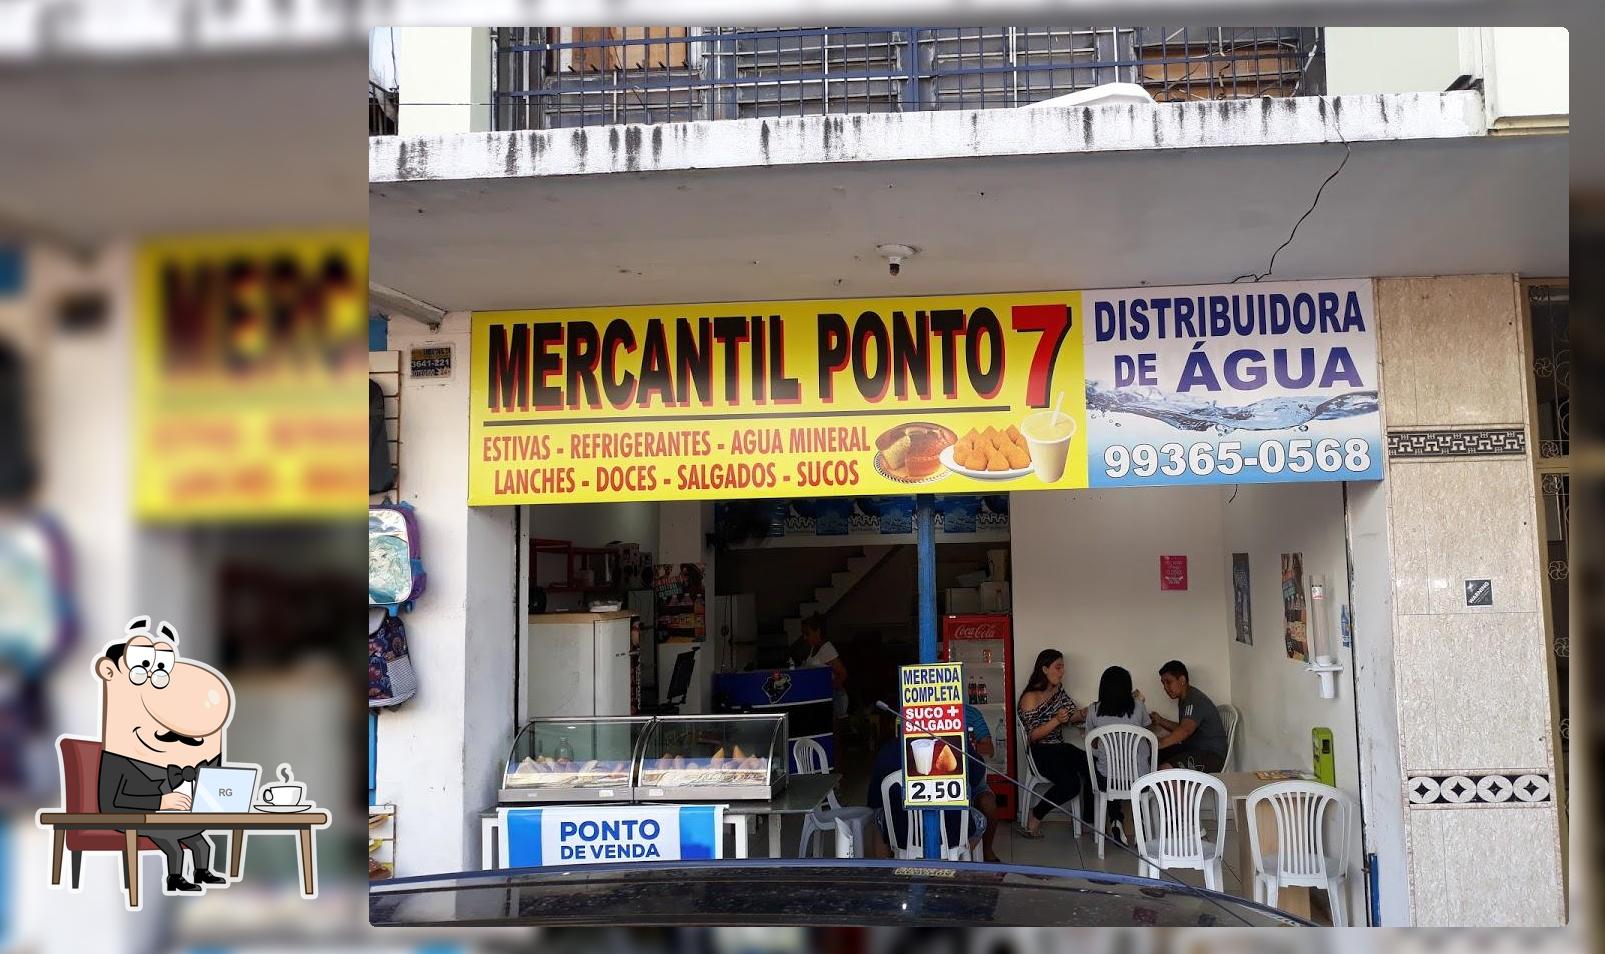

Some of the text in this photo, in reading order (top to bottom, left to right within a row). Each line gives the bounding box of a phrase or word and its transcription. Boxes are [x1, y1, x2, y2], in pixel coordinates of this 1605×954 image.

[1094, 290, 1366, 342] DISTRIBUIDORA
[488, 304, 1072, 413] MERCANTIL PONTO 7
[1114, 341, 1365, 393] DE ÁGUA
[483, 434, 551, 462] ESTIVAS
[570, 430, 712, 460] REFRIGERANTES
[731, 428, 785, 457] AGUA
[789, 426, 871, 455] MINERAL
[1103, 437, 1372, 480] 99365-0568
[494, 466, 575, 495] LANCHES
[596, 464, 657, 492] DOCES
[677, 462, 776, 490] SALGADOS
[797, 459, 860, 488] SUCOS
[903, 667, 960, 685] MERENDA
[904, 685, 961, 703] COMPLETA
[905, 706, 943, 720] SUCO
[905, 718, 961, 732] SALGADO
[911, 781, 961, 801] 2,50
[560, 819, 661, 842] PONTO
[561, 843, 661, 860] DE VENDA
